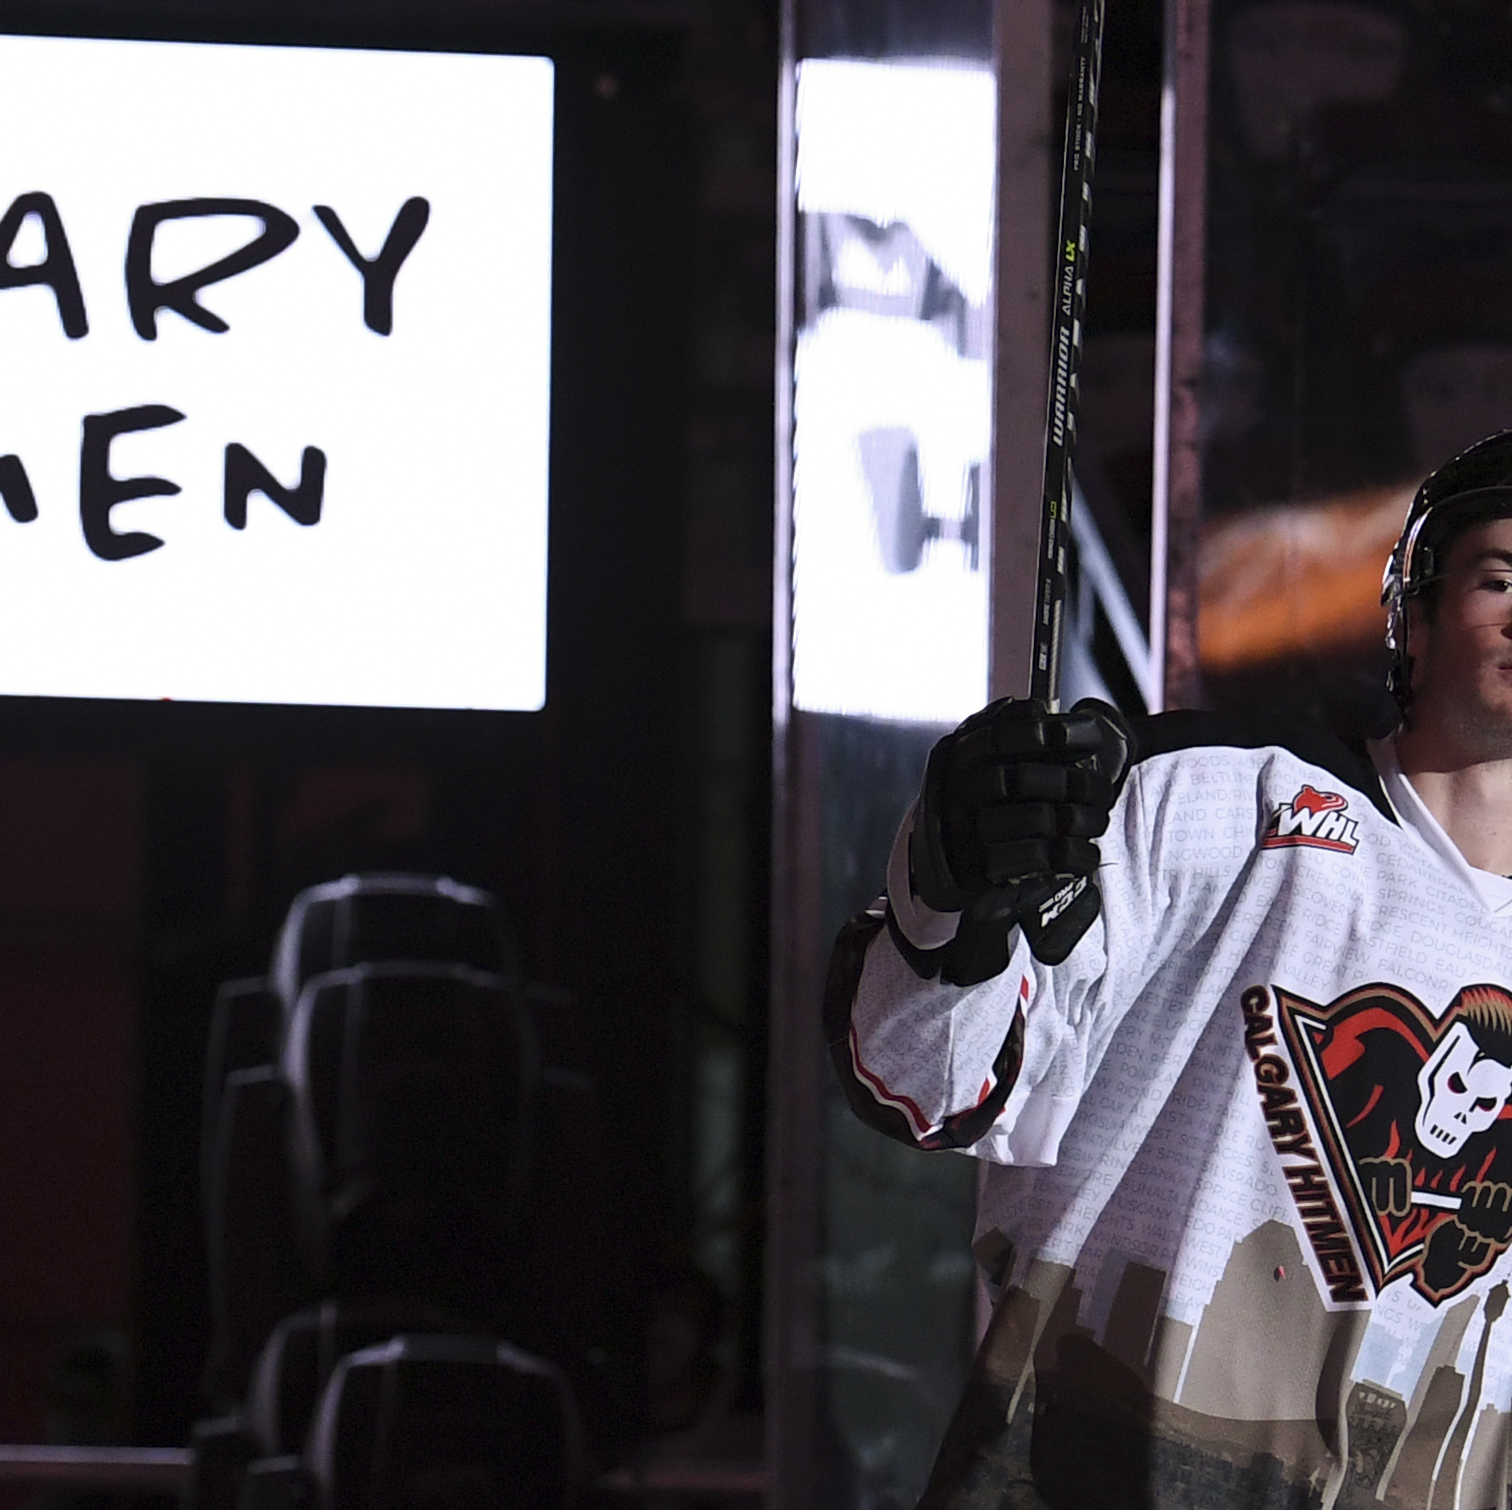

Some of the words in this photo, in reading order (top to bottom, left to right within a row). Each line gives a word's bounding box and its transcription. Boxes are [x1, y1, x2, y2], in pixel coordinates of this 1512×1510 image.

[1065, 239, 1076, 262] LX
[1061, 265, 1075, 317] ALPHA
[1052, 325, 1071, 447] WARRIOR
[1277, 804, 1359, 848] WHL
[1376, 869, 1419, 890] PARK
[1376, 887, 1446, 917] SPRINGS
[1240, 984, 1321, 1167] CALGARY
[1281, 1163, 1371, 1304] HITMEN
[1201, 1159, 1279, 1197] SILVERADO
